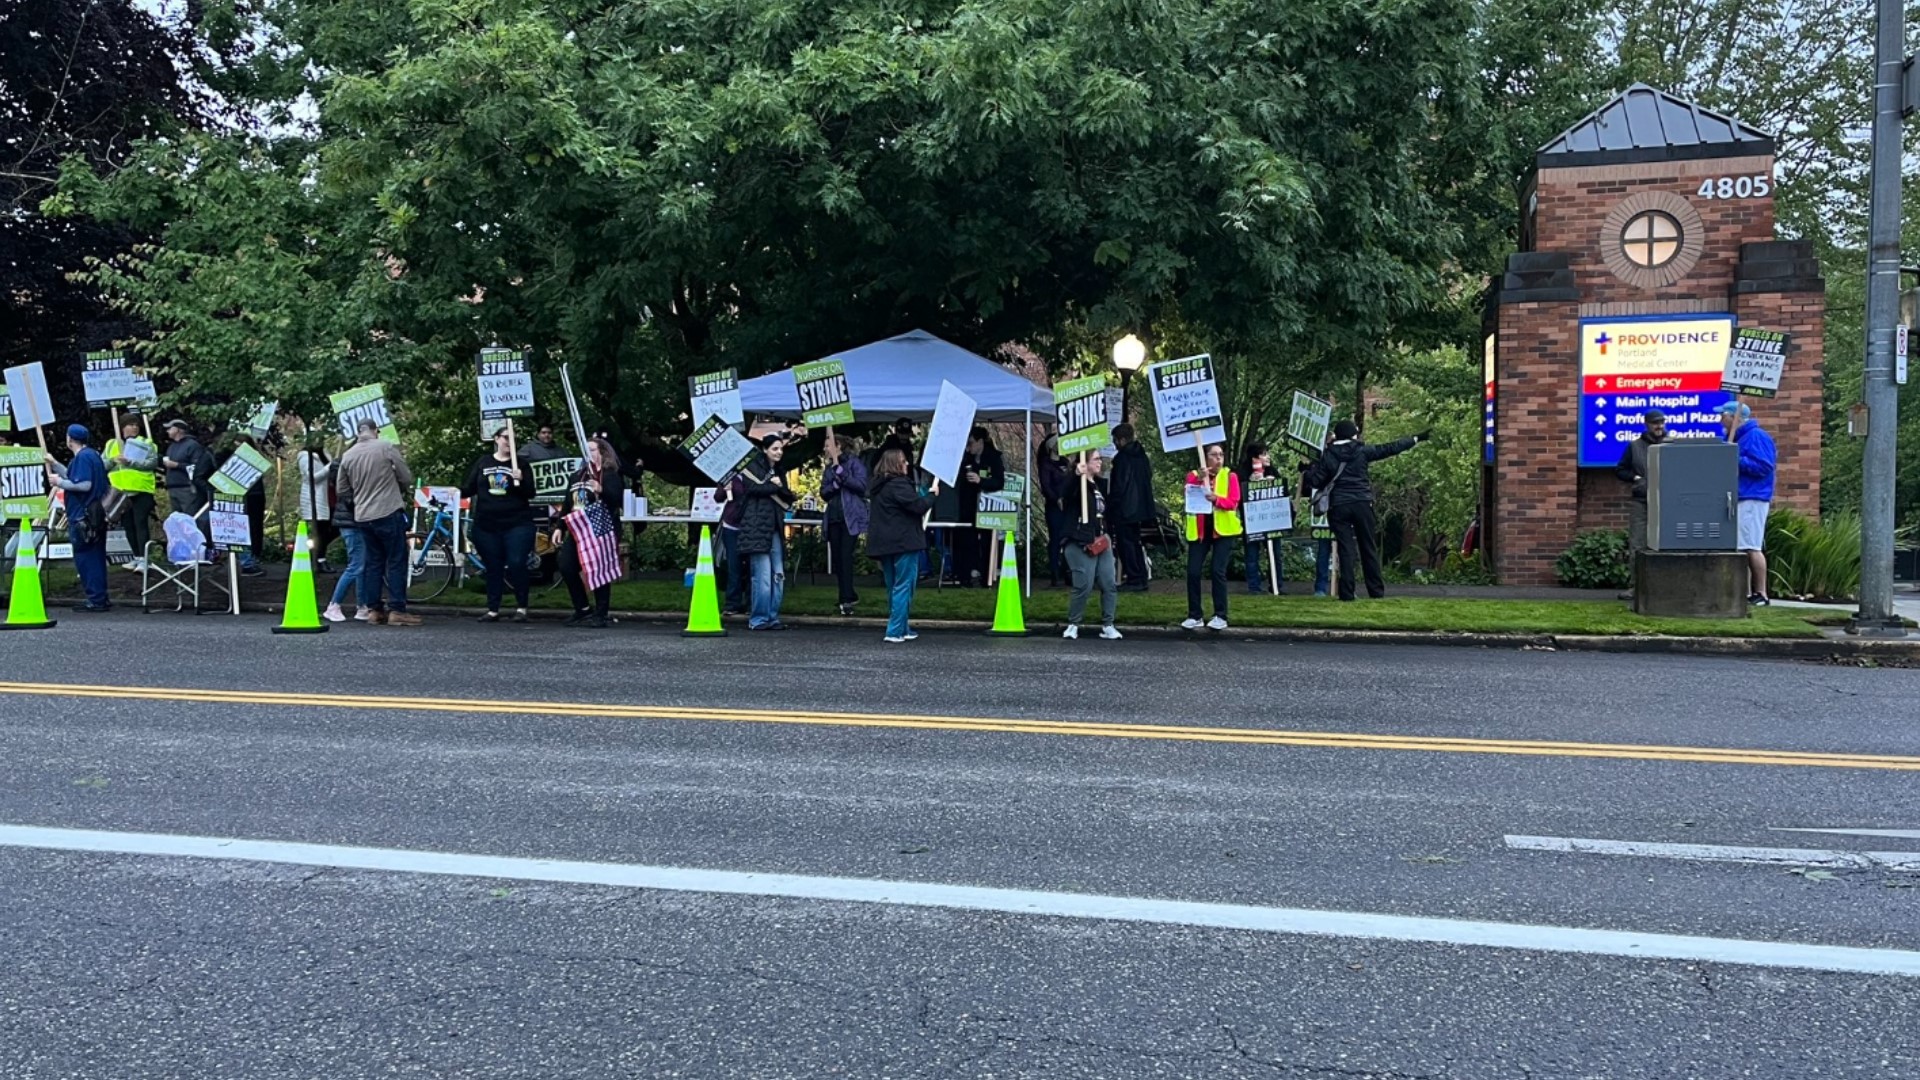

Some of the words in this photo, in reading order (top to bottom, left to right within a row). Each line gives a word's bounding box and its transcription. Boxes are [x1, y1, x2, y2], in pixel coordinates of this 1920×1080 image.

[1697, 176, 1769, 200] 4805
[1618, 332, 1719, 346] PROVIDENCE
[1739, 328, 1771, 340] NURSES
[1771, 333, 1784, 341] ON
[1618, 349, 1658, 358] Portland
[1734, 336, 1783, 354] STRIKE
[86, 358, 126, 371] STRIKE
[482, 360, 525, 375] STRIKE
[1161, 361, 1191, 376] NURSES
[1192, 358, 1204, 369] ON
[1617, 359, 1654, 368] Medical
[1656, 359, 1688, 368] Center
[1735, 360, 1752, 368] CEO
[796, 365, 829, 382] NURSES
[830, 363, 842, 374] ON
[1162, 367, 1207, 389] STRIKE
[695, 378, 734, 396] STRIKE
[1058, 382, 1090, 400] NURSES
[1091, 379, 1105, 391] ON
[1616, 377, 1682, 390] Emergency
[799, 374, 848, 411] STRIKE
[1616, 397, 1647, 408] Main
[1650, 395, 1700, 409] Hospital
[807, 412, 835, 425] ONA
[1058, 392, 1106, 435] STRIKE
[1690, 411, 1722, 424] Plaza
[1289, 411, 1327, 447] STRIKE
[689, 422, 725, 458] STRIKE
[1062, 435, 1090, 451] ONA
[220, 456, 263, 489] STRIKE
[533, 460, 576, 477] TRIKE
[1, 465, 45, 498] STRIKE
[535, 473, 571, 490] EADY
[1247, 486, 1285, 501] STRIKE
[212, 500, 245, 513] STRIKE
